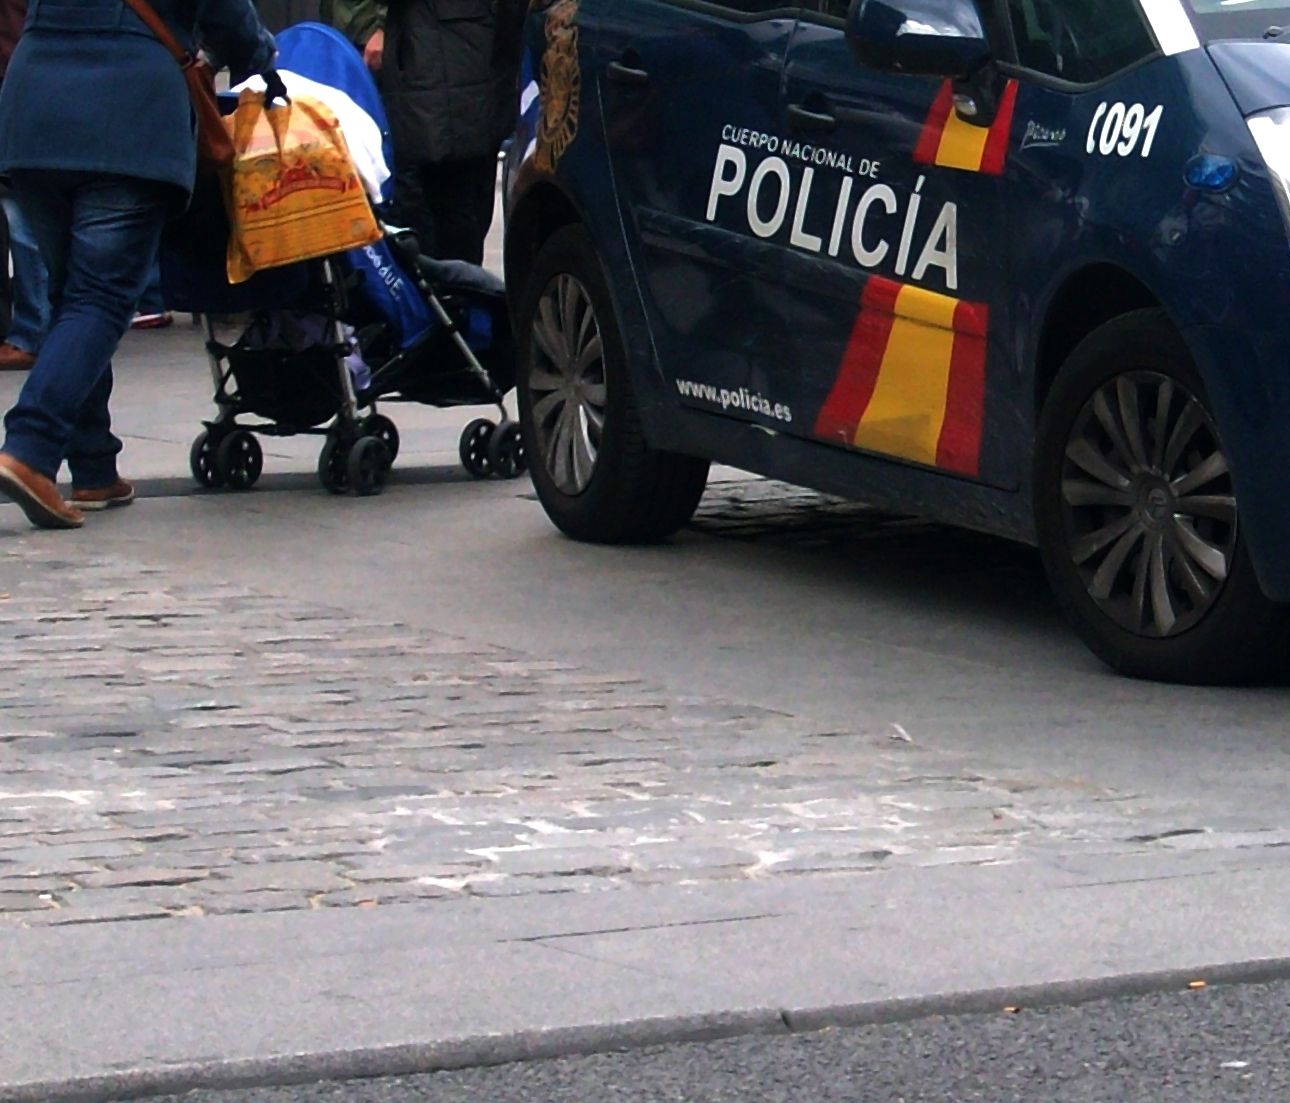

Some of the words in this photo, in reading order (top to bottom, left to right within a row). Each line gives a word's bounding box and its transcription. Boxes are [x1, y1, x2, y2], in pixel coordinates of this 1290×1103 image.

[721, 124, 778, 152] CUERPO
[781, 139, 854, 174] NACIONAL
[858, 158, 881, 180] DE
[1099, 101, 1164, 158] 091
[705, 143, 958, 290] POLICÍA
[675, 378, 793, 423] www.policia.es
